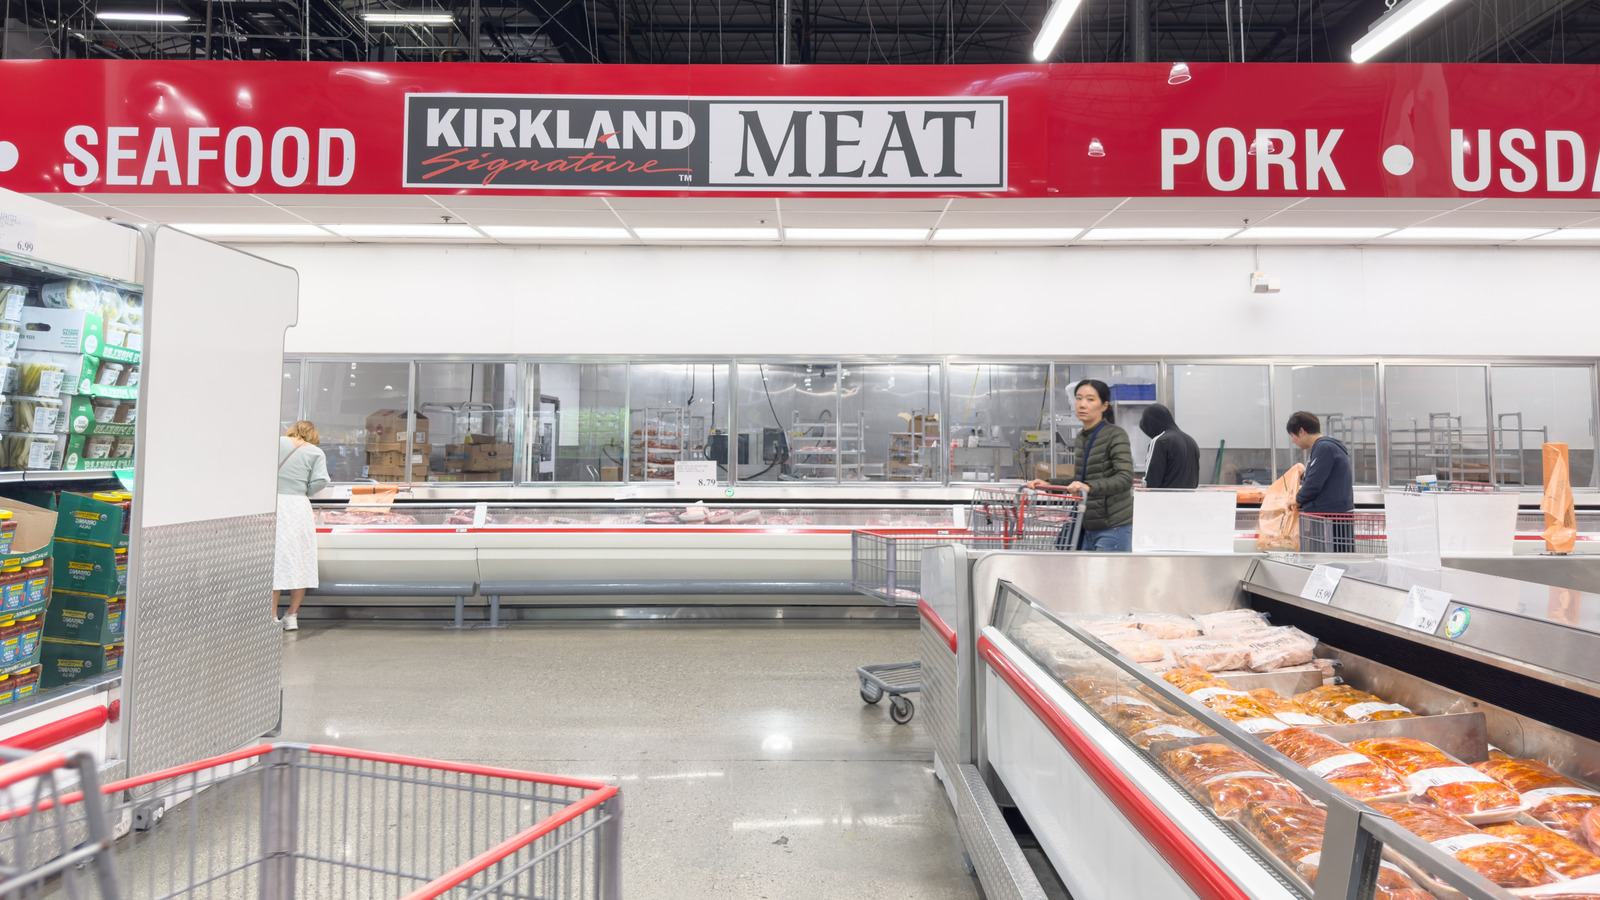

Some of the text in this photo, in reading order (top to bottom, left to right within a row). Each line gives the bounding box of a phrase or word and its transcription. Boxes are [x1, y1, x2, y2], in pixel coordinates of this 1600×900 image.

[426, 108, 696, 150] KIRKLAND
[734, 110, 977, 178] MEAT
[62, 125, 356, 187] SEAFOOD
[421, 148, 693, 186] Signature TM
[1160, 127, 1600, 193] PORK USD
[16, 240, 34, 252] 6.99
[698, 479, 716, 487] 8.79
[1314, 588, 1332, 599] 15.99
